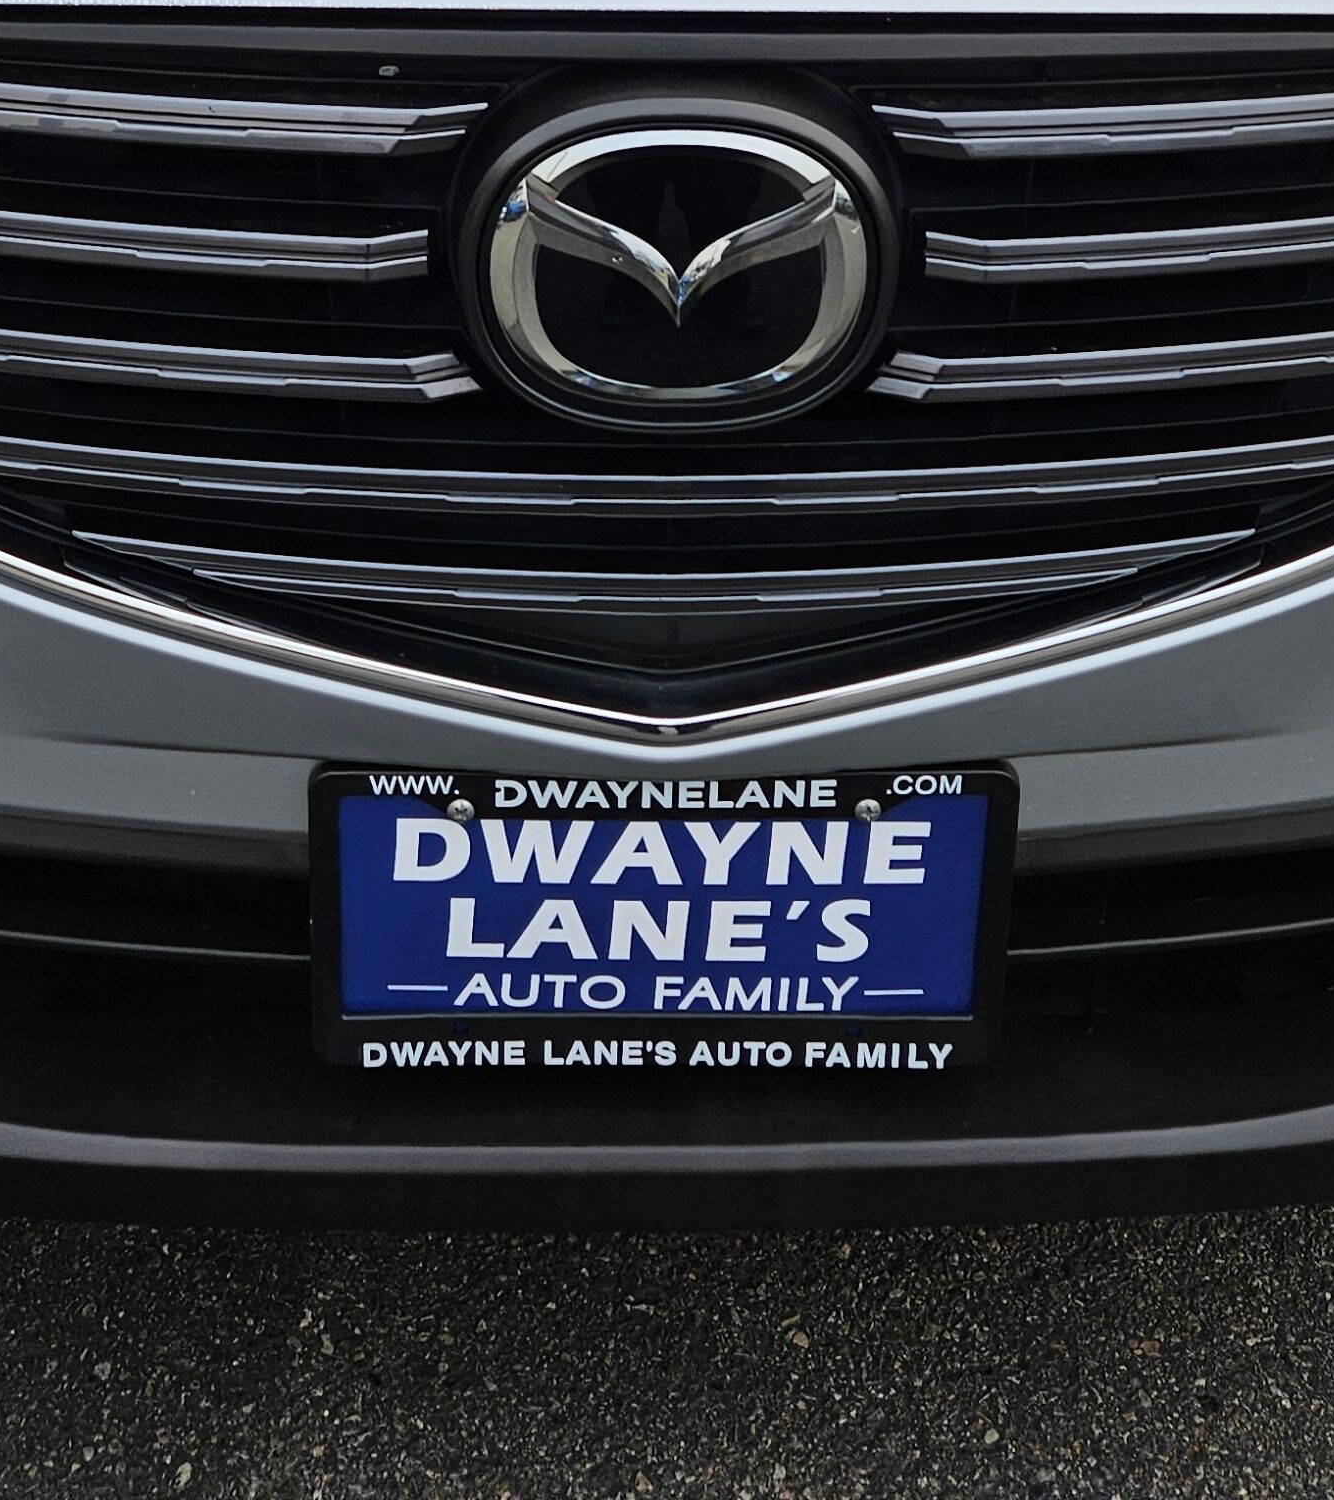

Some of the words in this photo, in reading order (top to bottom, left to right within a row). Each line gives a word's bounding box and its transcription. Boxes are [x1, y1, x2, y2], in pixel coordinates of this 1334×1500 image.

[368, 774, 460, 796] WWW.
[495, 779, 838, 809] DWAYNELANE
[886, 774, 963, 796] .COM
[392, 817, 932, 886] DWAYNE
[446, 897, 871, 962] LANE'S
[453, 972, 626, 1010] AUTO
[653, 975, 859, 1012] FAMILY
[362, 1040, 526, 1068] DWAYNE
[543, 1039, 677, 1066] LANE'S
[689, 1040, 793, 1068] AUTO
[804, 1041, 953, 1070] FAMILY
